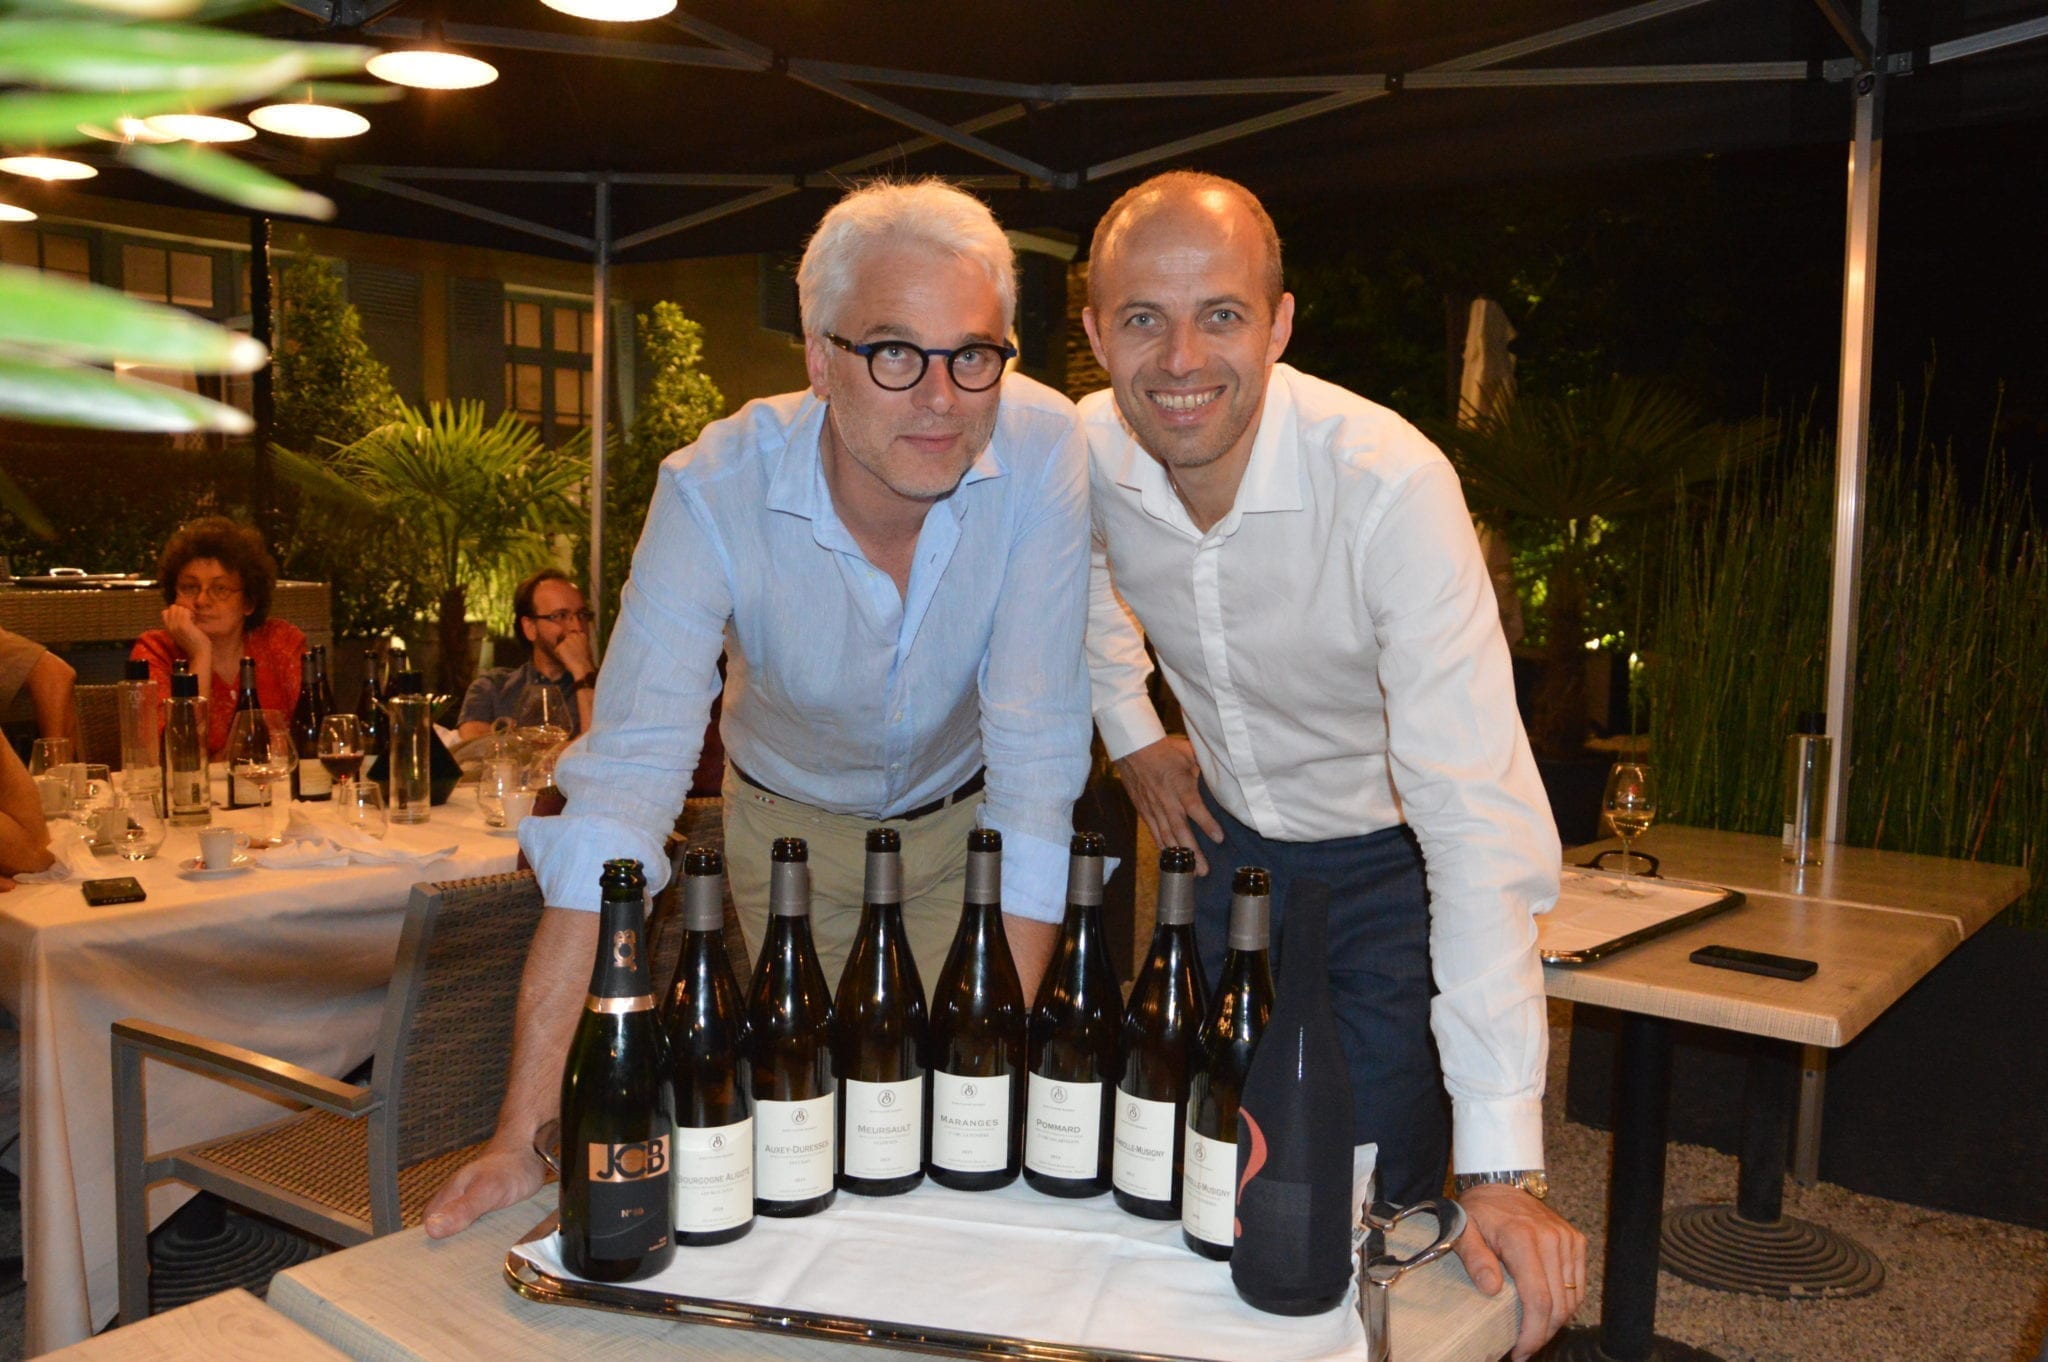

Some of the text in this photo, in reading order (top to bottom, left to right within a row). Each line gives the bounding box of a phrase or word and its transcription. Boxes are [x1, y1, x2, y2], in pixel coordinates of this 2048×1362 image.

[940, 1114, 999, 1127] MARANGES
[1036, 1118, 1081, 1134] POMMARD
[857, 1123, 912, 1136] MEURSAULT
[597, 1139, 665, 1180] JCB
